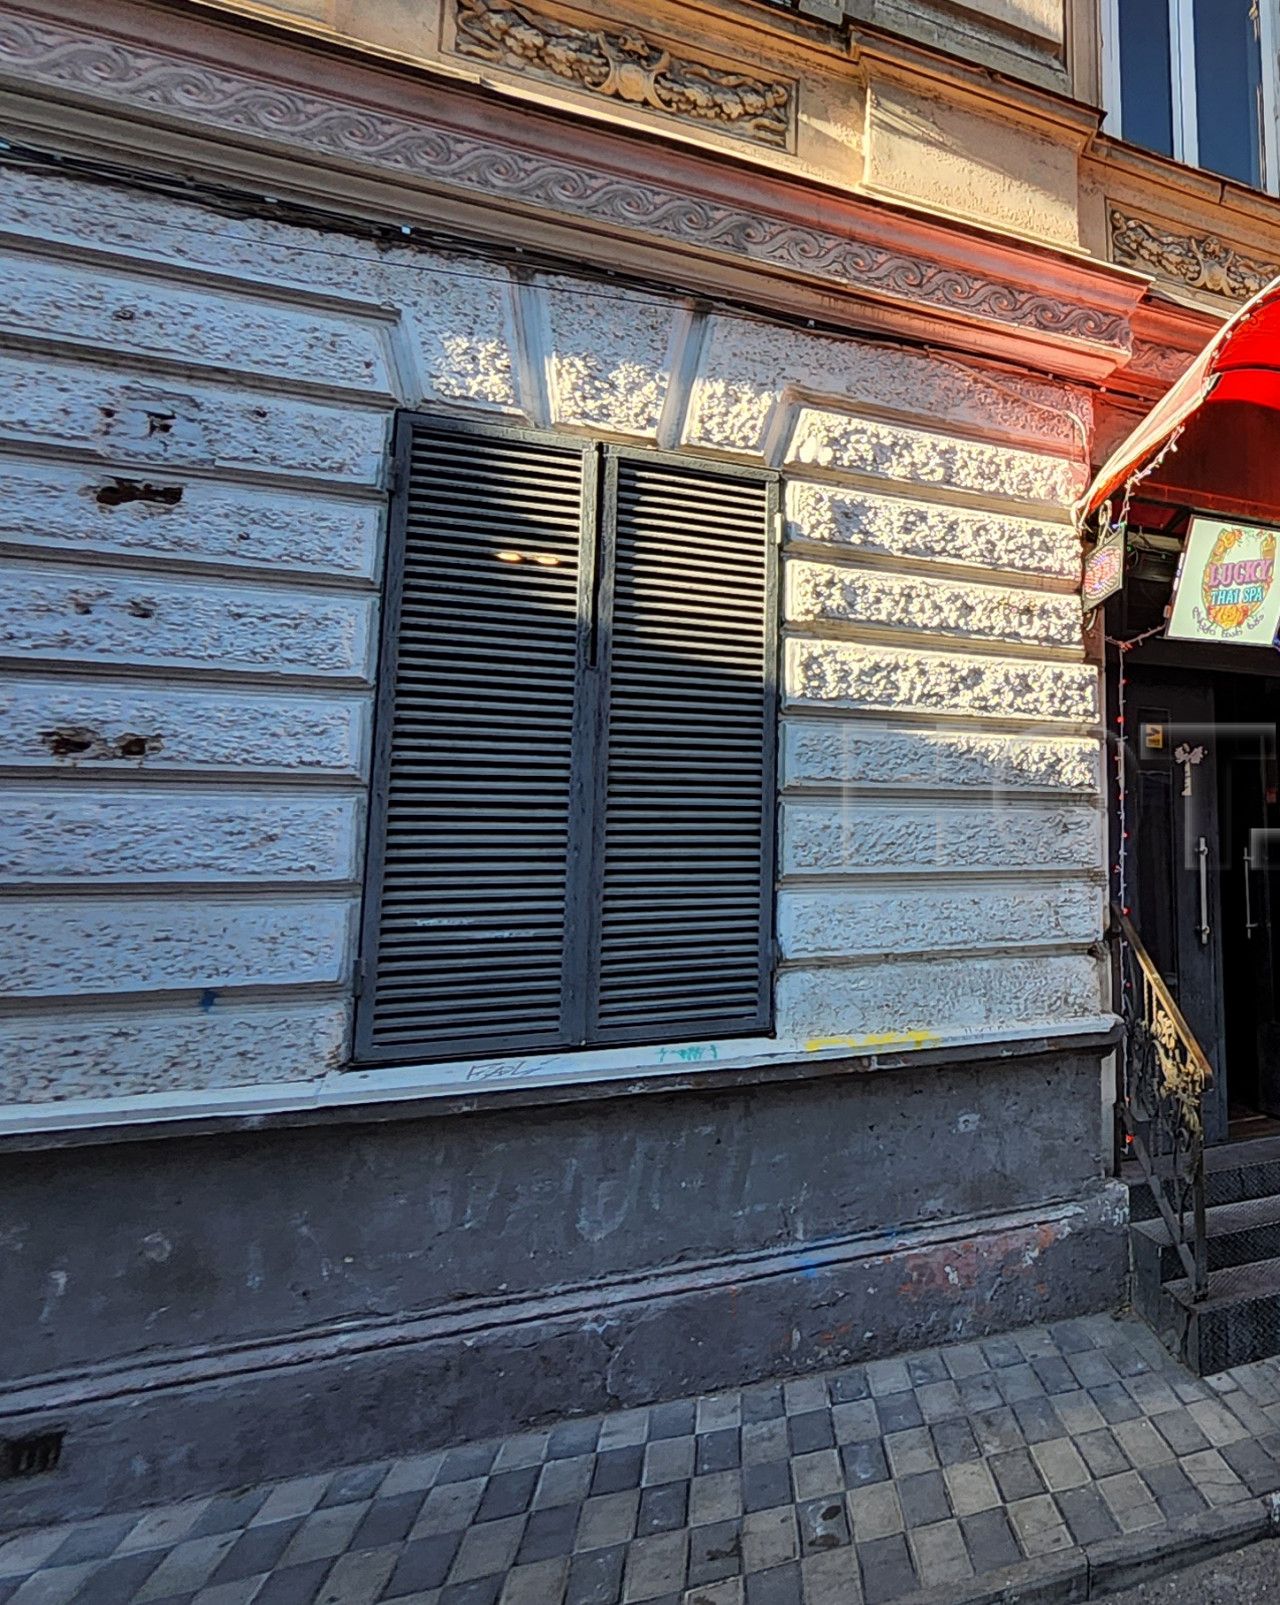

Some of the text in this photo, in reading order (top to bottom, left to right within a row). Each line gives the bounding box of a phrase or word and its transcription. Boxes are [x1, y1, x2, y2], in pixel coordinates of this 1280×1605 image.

[1209, 560, 1272, 587] LUCKY
[1211, 586, 1264, 606] THAI SPA
